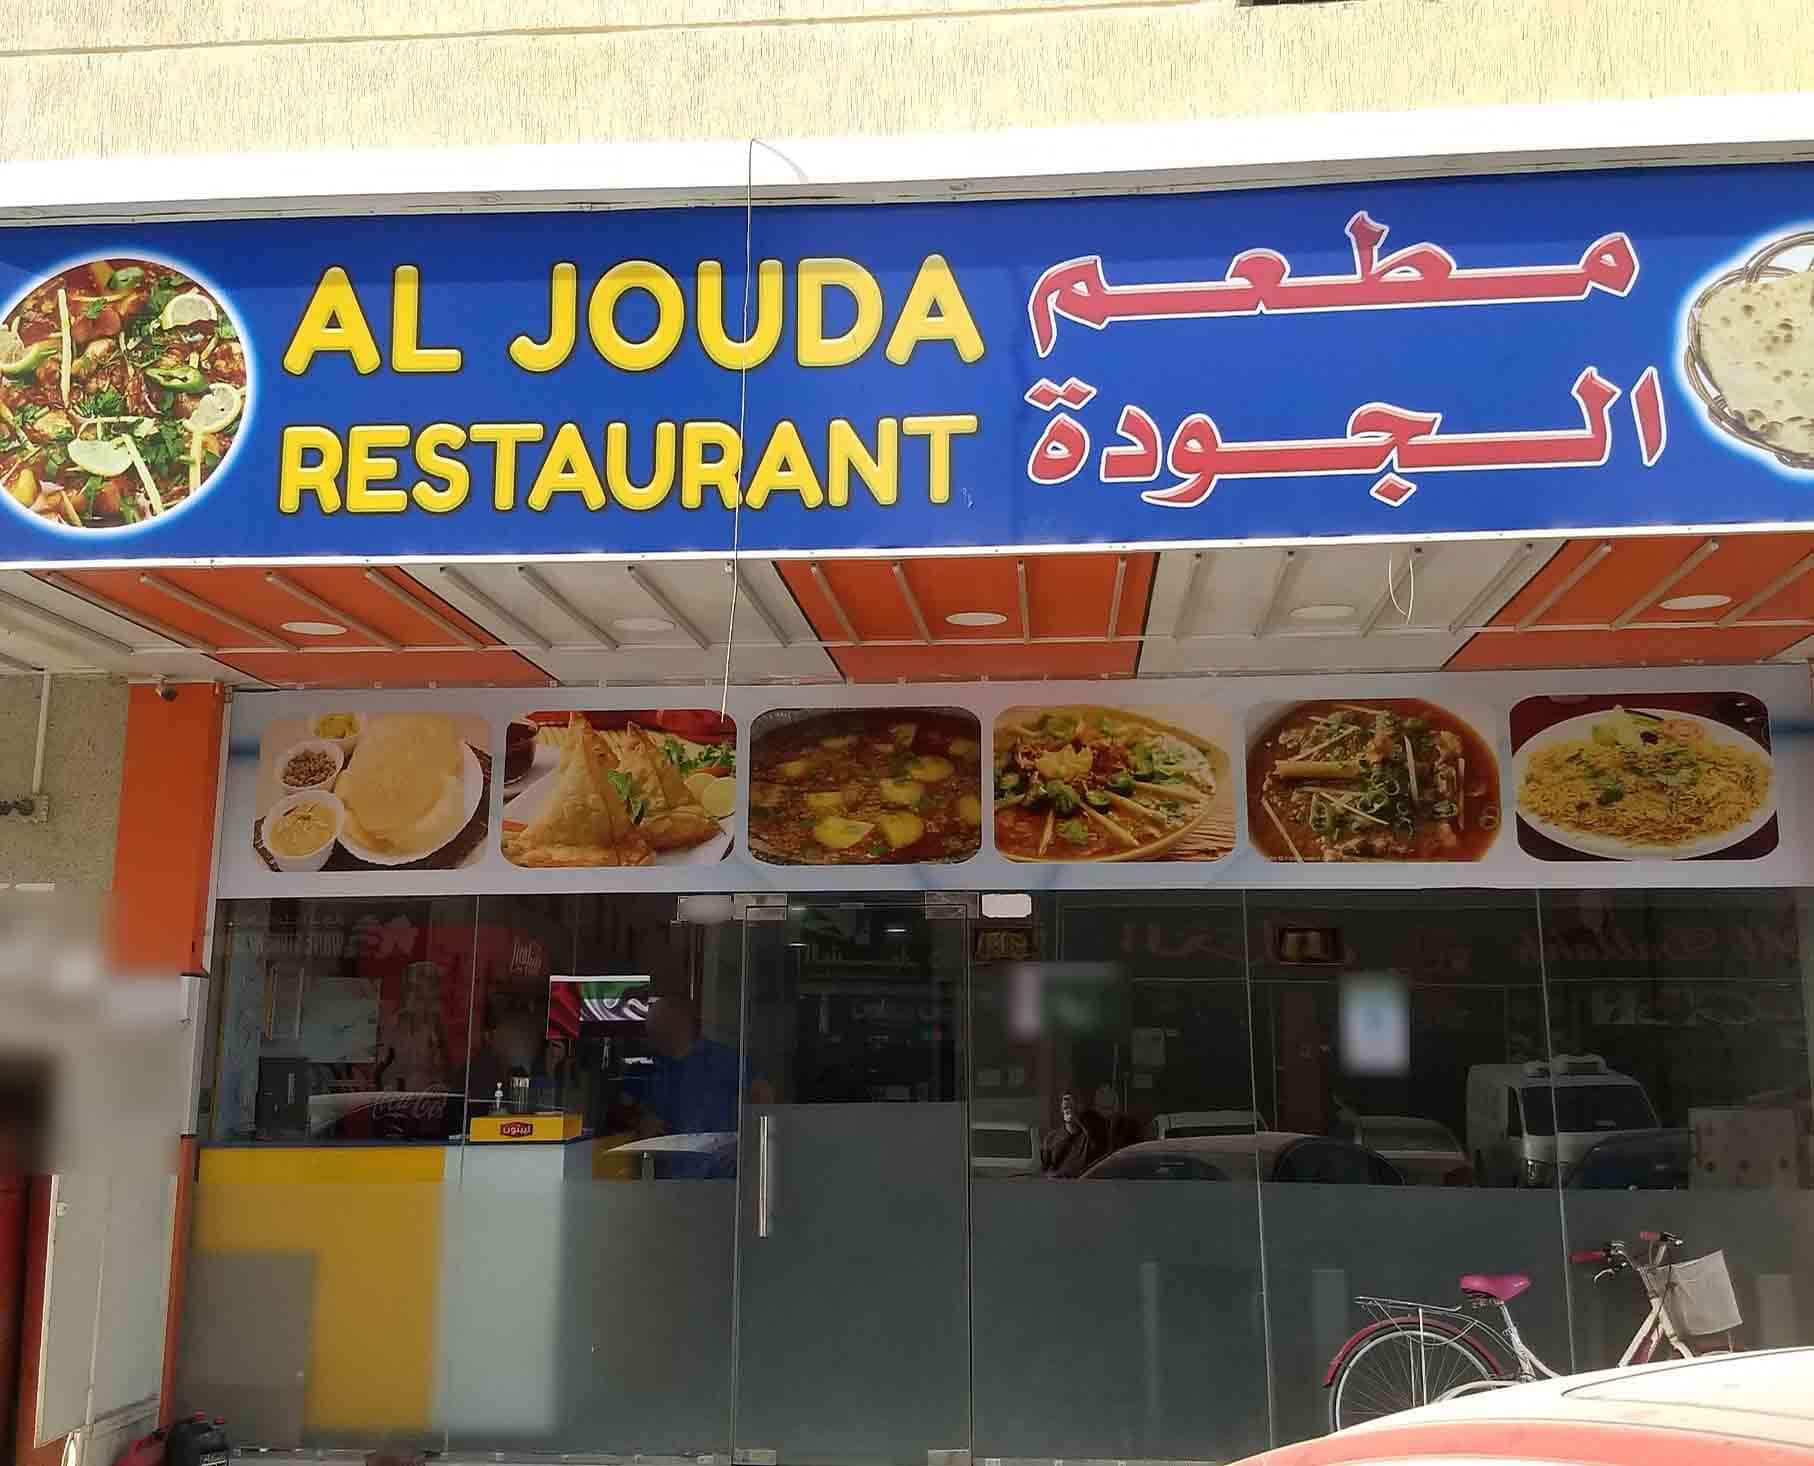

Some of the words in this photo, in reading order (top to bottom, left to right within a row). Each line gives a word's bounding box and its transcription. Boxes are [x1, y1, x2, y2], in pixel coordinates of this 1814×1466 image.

[282, 264, 463, 375] AL
[508, 254, 985, 372] JOUDA
[1027, 211, 1640, 358] مطعم
[279, 414, 979, 513] RESTAURANT
[1025, 366, 1667, 507] الجودة
